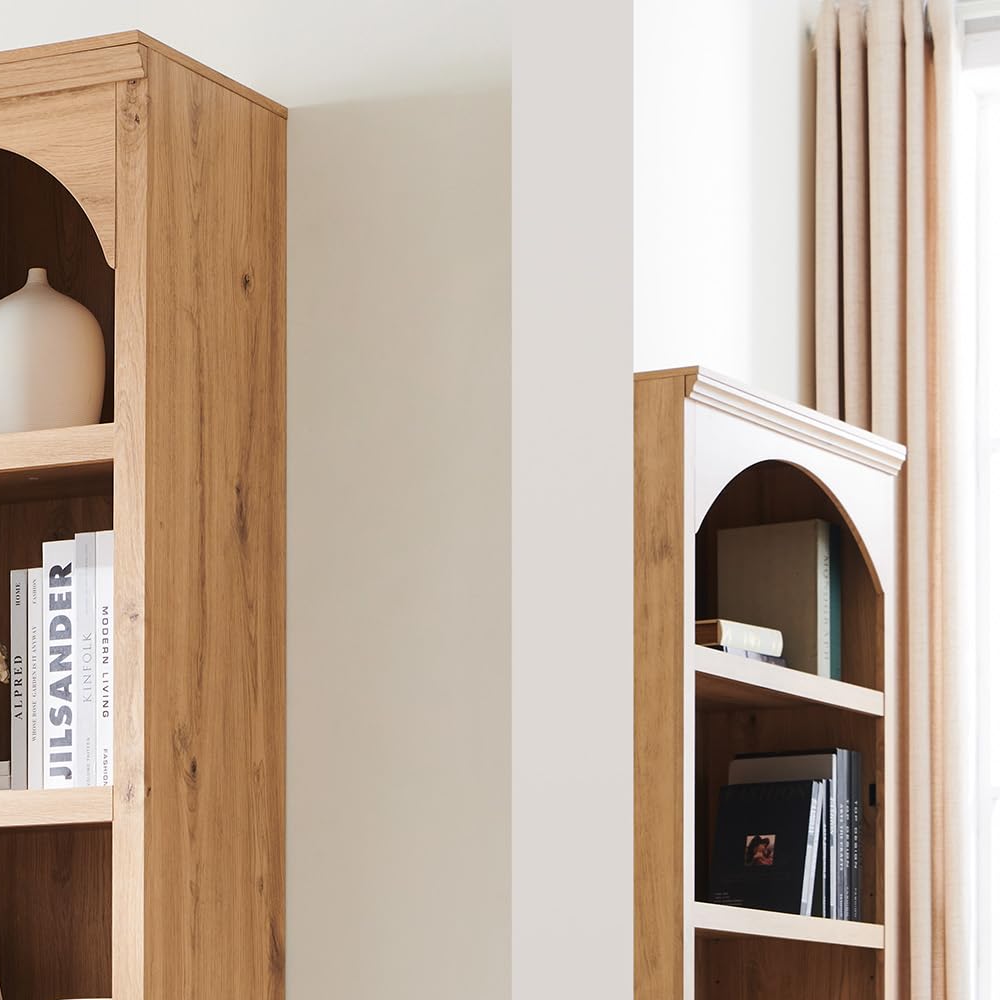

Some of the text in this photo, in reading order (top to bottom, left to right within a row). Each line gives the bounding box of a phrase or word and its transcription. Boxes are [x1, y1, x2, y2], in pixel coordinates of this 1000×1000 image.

[14, 655, 23, 720] ALPRED
[49, 562, 72, 780] JILSANDER
[82, 632, 92, 703] KINFOLK
[102, 672, 110, 718] LIVING
